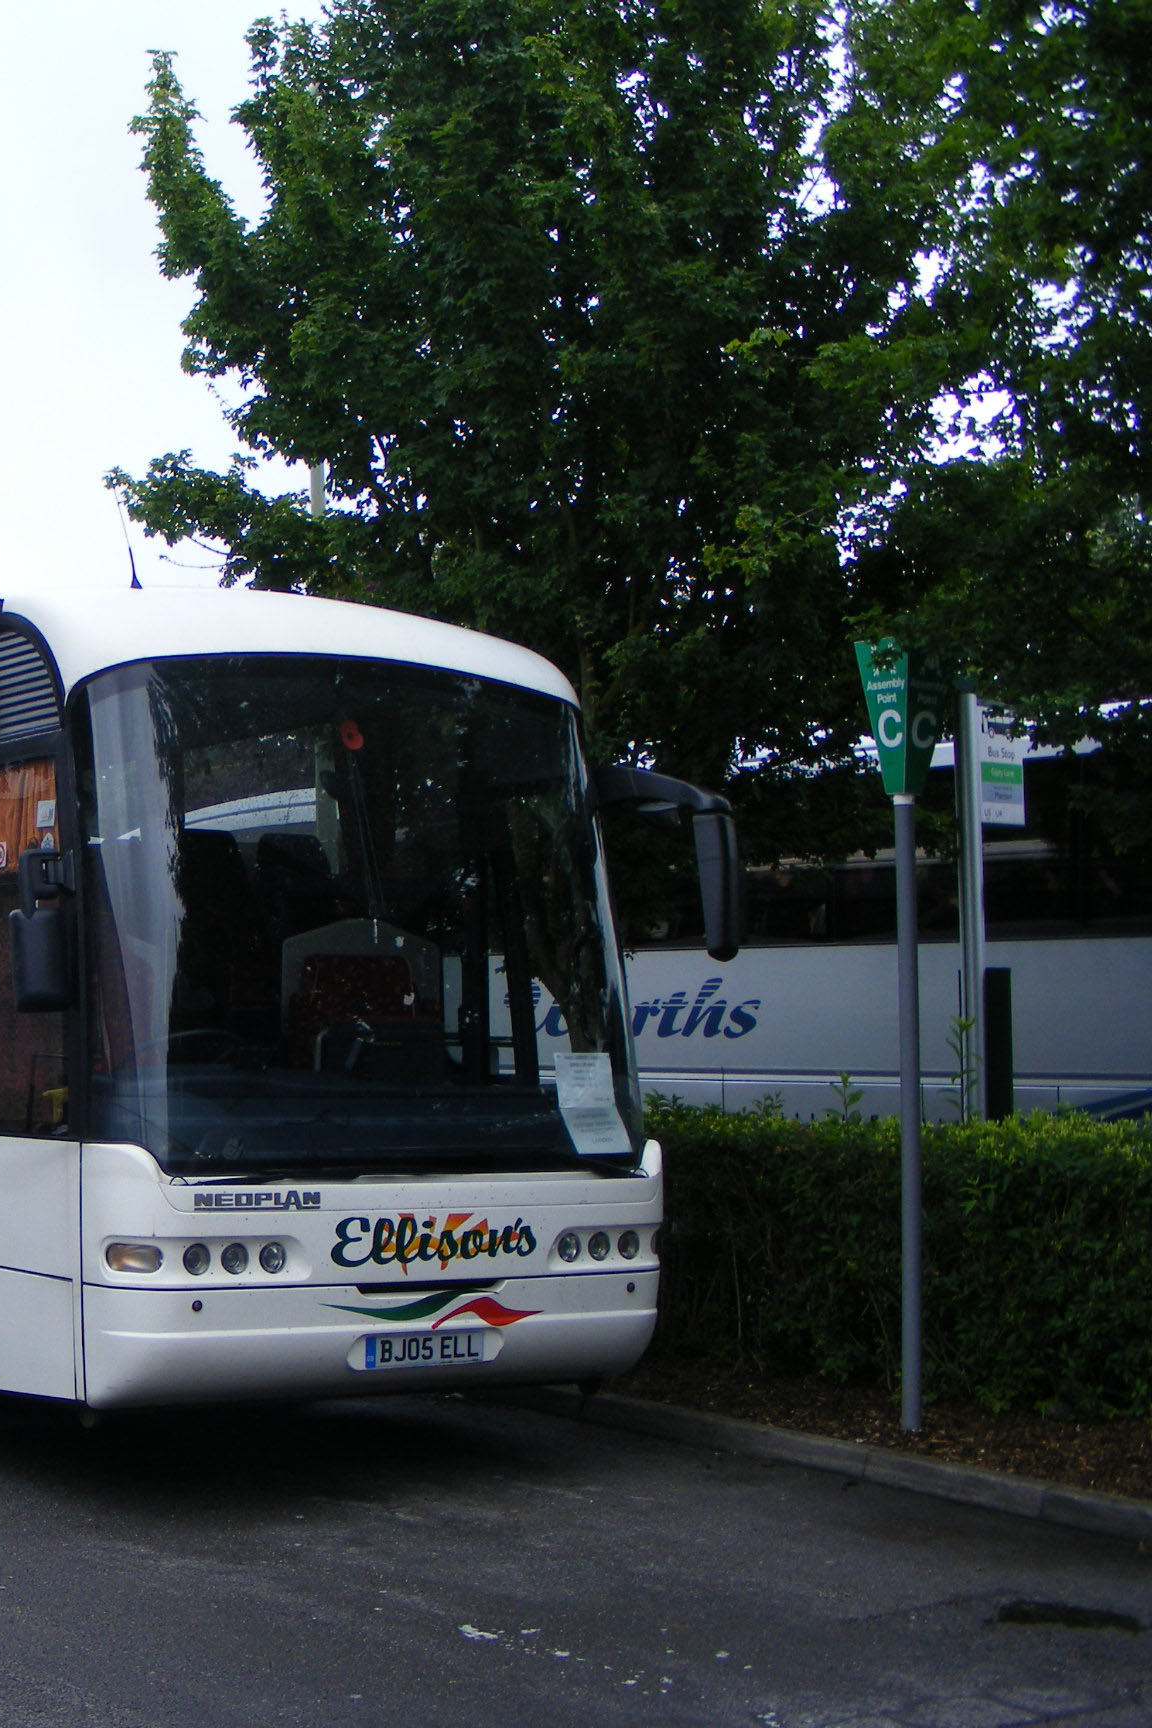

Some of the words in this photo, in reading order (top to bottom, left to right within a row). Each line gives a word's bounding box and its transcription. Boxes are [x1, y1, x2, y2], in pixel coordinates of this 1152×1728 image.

[867, 678, 905, 691] Assembly
[876, 693, 897, 704] Point
[878, 709, 903, 748] C
[912, 711, 937, 748] C
[988, 745, 999, 758] Bus
[1001, 747, 1015, 761] Stop
[194, 1190, 321, 1210] NEOPLAN
[331, 1216, 538, 1268] Ellison's
[380, 1337, 434, 1363] BJ05
[440, 1335, 479, 1359] ELL
